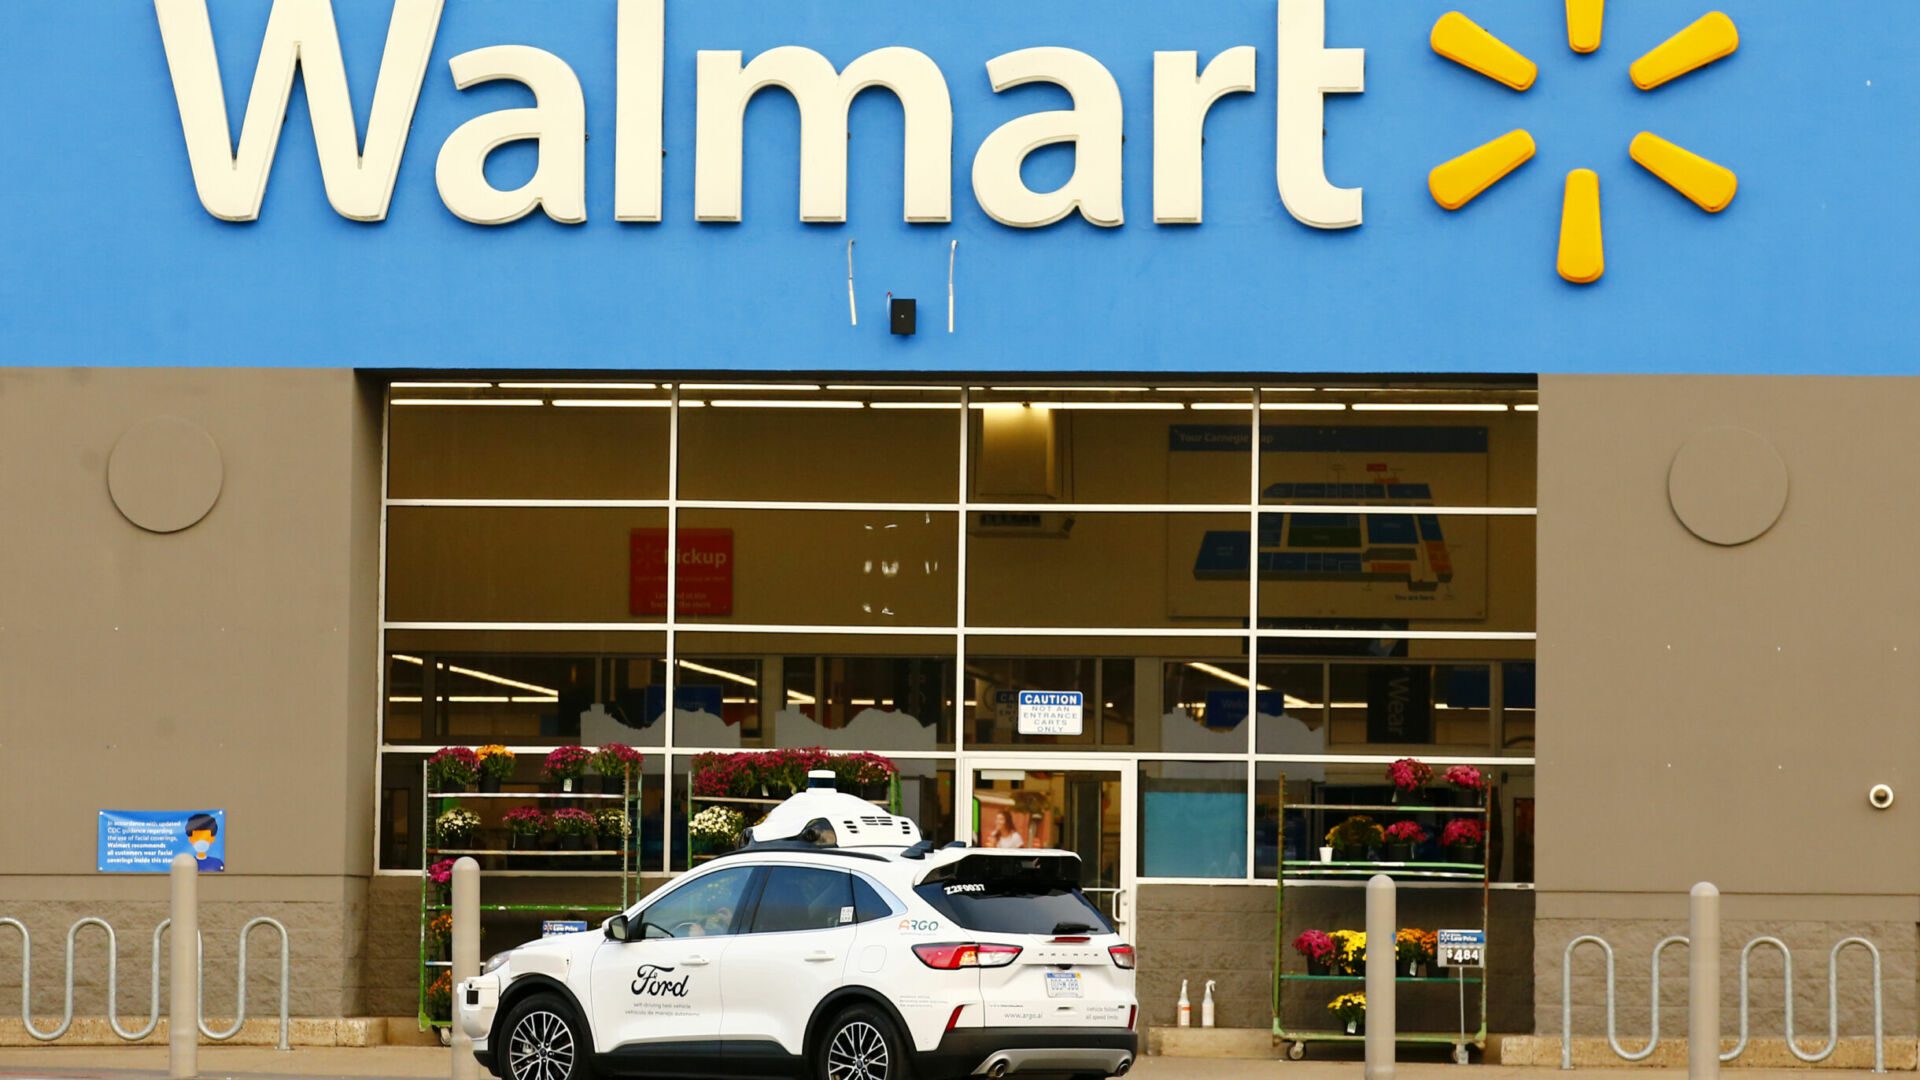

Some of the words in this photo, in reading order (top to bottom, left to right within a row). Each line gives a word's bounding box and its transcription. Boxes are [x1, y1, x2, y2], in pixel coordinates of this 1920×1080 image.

[155, 0, 1364, 229] Walmart
[664, 547, 727, 569] ickup
[1024, 694, 1077, 704] CAUTION
[1387, 677, 1410, 736] Wear
[943, 883, 986, 896] Z2F0037
[898, 919, 939, 931] ARGO
[630, 964, 690, 998] Ford
